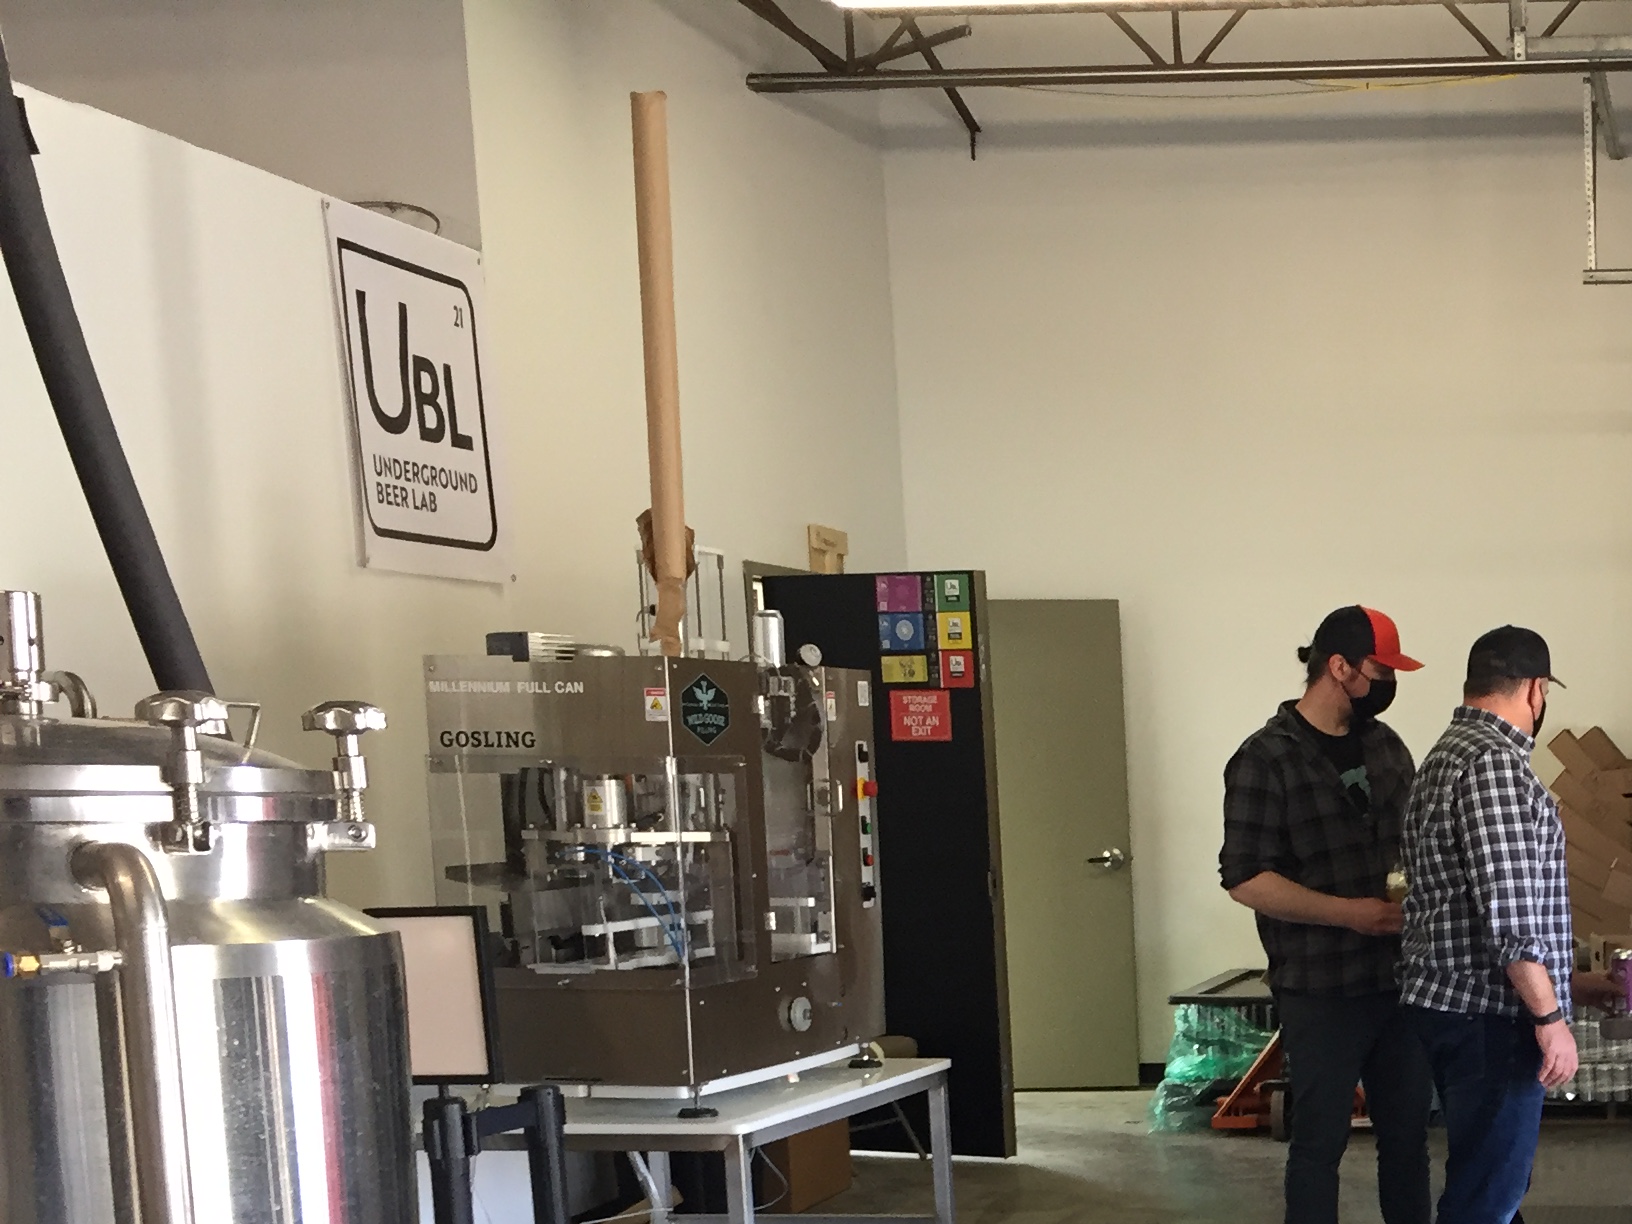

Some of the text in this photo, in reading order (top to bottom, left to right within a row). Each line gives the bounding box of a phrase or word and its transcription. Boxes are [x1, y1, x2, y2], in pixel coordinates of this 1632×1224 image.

[453, 305, 464, 329] 21
[354, 289, 474, 452] UBL
[372, 453, 478, 495] UNDERGROUND
[375, 480, 438, 513] BEER LAB
[428, 680, 511, 693] MILLENNIUM
[554, 680, 584, 694] CAN
[902, 695, 938, 704] STORAGE
[903, 715, 940, 727] NOT AN
[439, 730, 536, 749] GOSLING
[911, 726, 933, 736] EXIT
